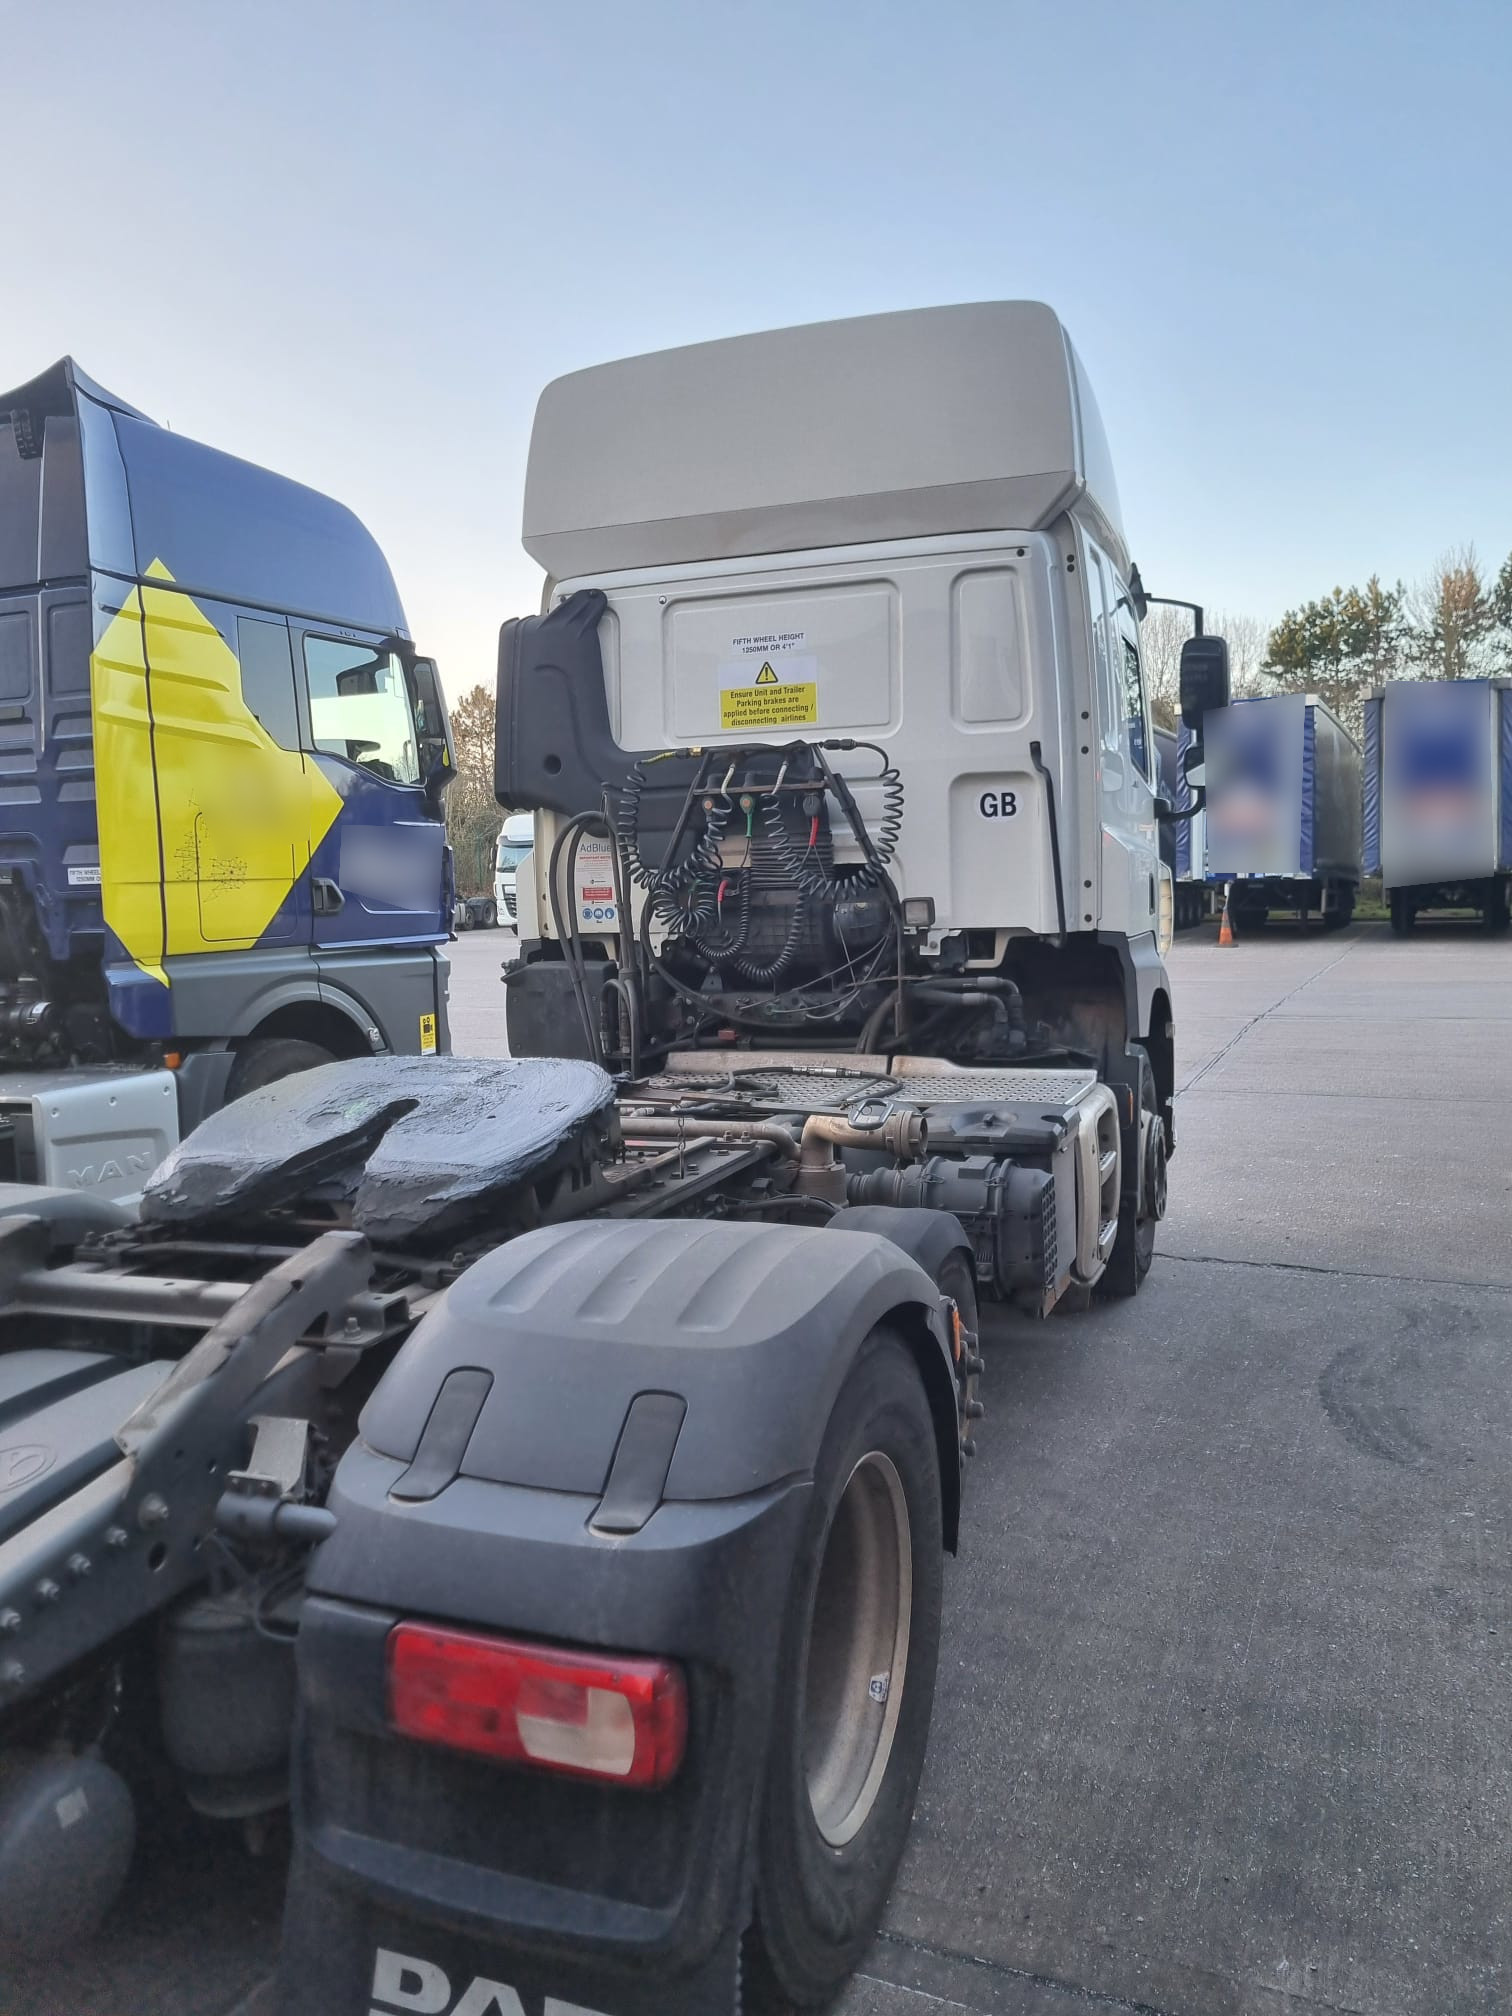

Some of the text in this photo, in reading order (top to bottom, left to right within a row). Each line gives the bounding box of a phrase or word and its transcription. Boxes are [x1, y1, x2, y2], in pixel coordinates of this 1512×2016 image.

[732, 632, 804, 646] FIFTH WHEEL HEIGHT
[742, 645, 769, 653] 1250MM
[770, 643, 781, 651] OR
[730, 691, 753, 699] Ensure
[754, 689, 768, 697] Unit
[783, 686, 805, 694] Trailer
[736, 699, 762, 707] Parking
[763, 697, 786, 705] brakes
[723, 709, 748, 718] applied
[748, 708, 770, 716] before
[771, 705, 809, 714] connecting
[731, 714, 806, 726] disconnecting airlines
[980, 792, 1017, 818] GB
[580, 843, 612, 852] AdBlue
[67, 1151, 151, 1187] MAN
[370, 1947, 616, 2016] DA
